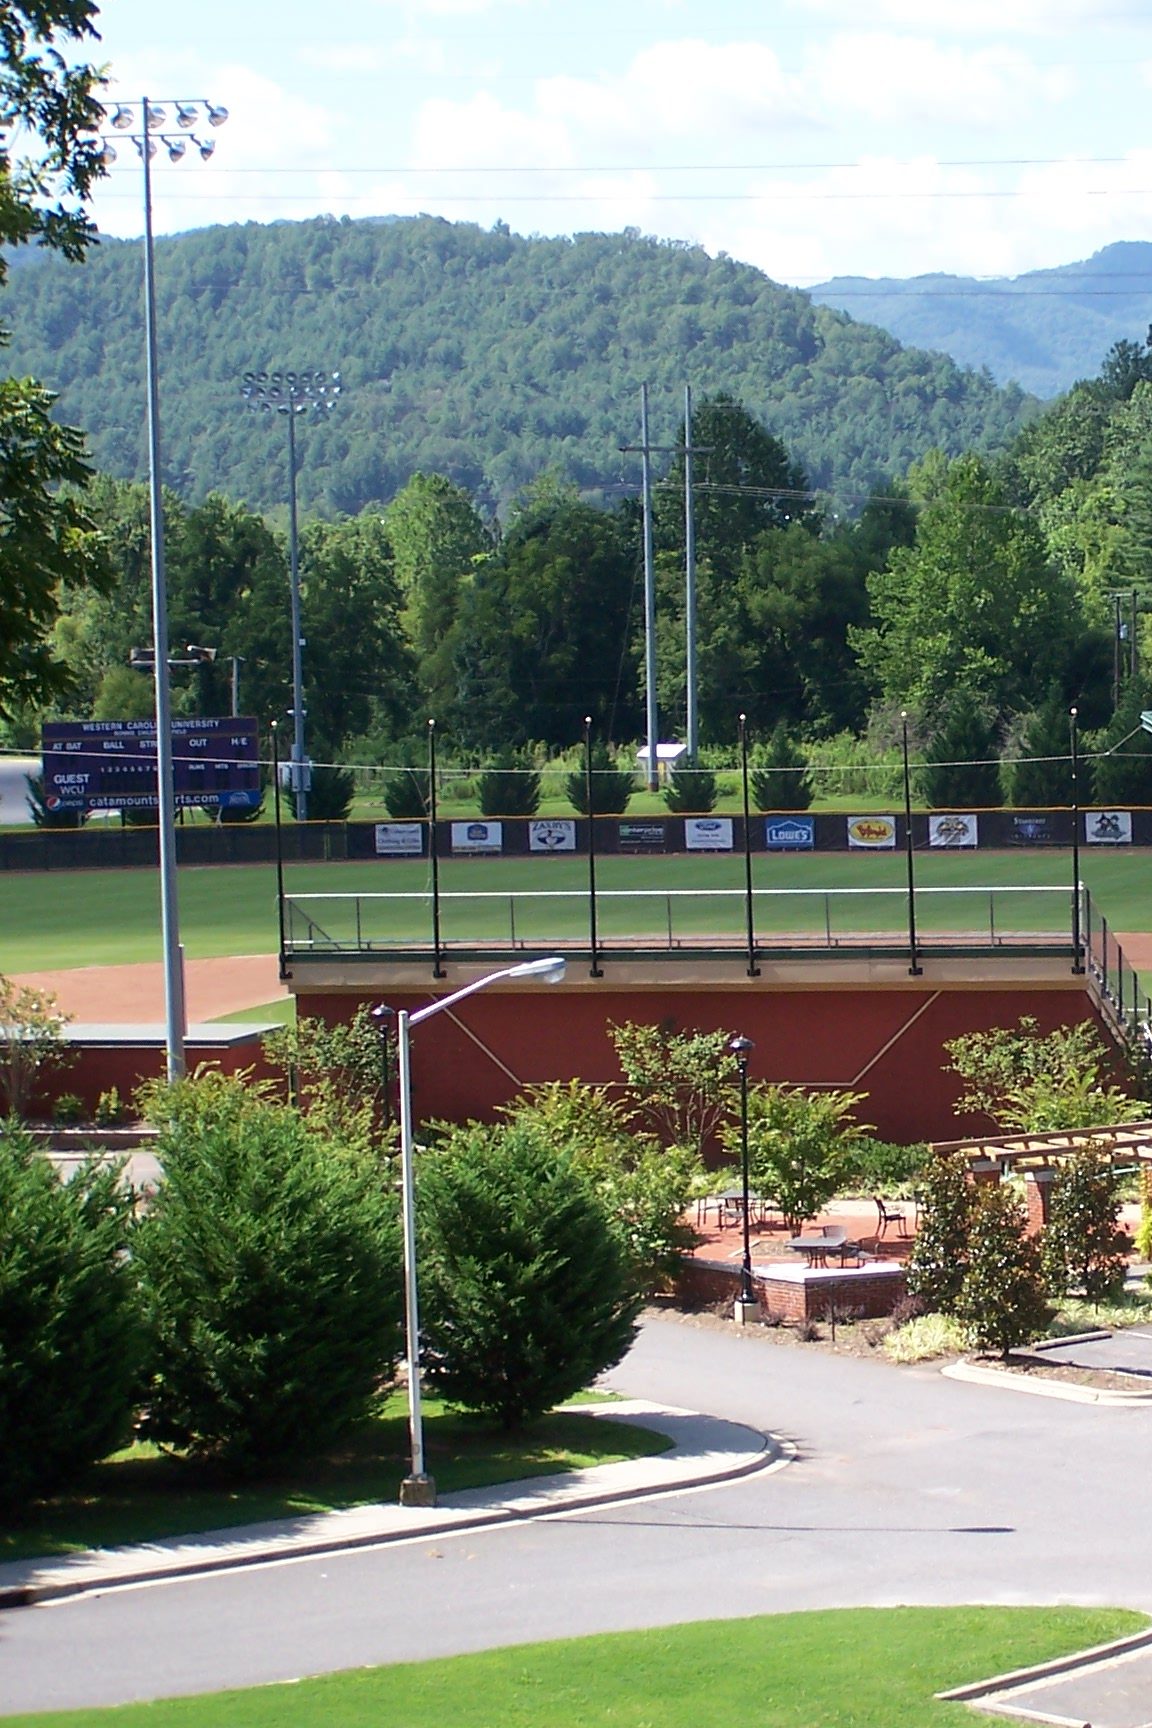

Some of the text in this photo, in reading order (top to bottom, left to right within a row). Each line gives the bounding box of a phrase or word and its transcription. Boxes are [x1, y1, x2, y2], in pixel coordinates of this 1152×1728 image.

[82, 723, 122, 731] WESTERN
[171, 720, 219, 728] UNIVERSITY
[52, 743, 63, 751] AT
[103, 741, 125, 750] BALL
[188, 738, 207, 747] OUT
[53, 774, 90, 784] GUEST
[60, 785, 85, 795] WCU
[89, 794, 219, 807] catamountsrts.com
[772, 829, 808, 841] LOWE'S
